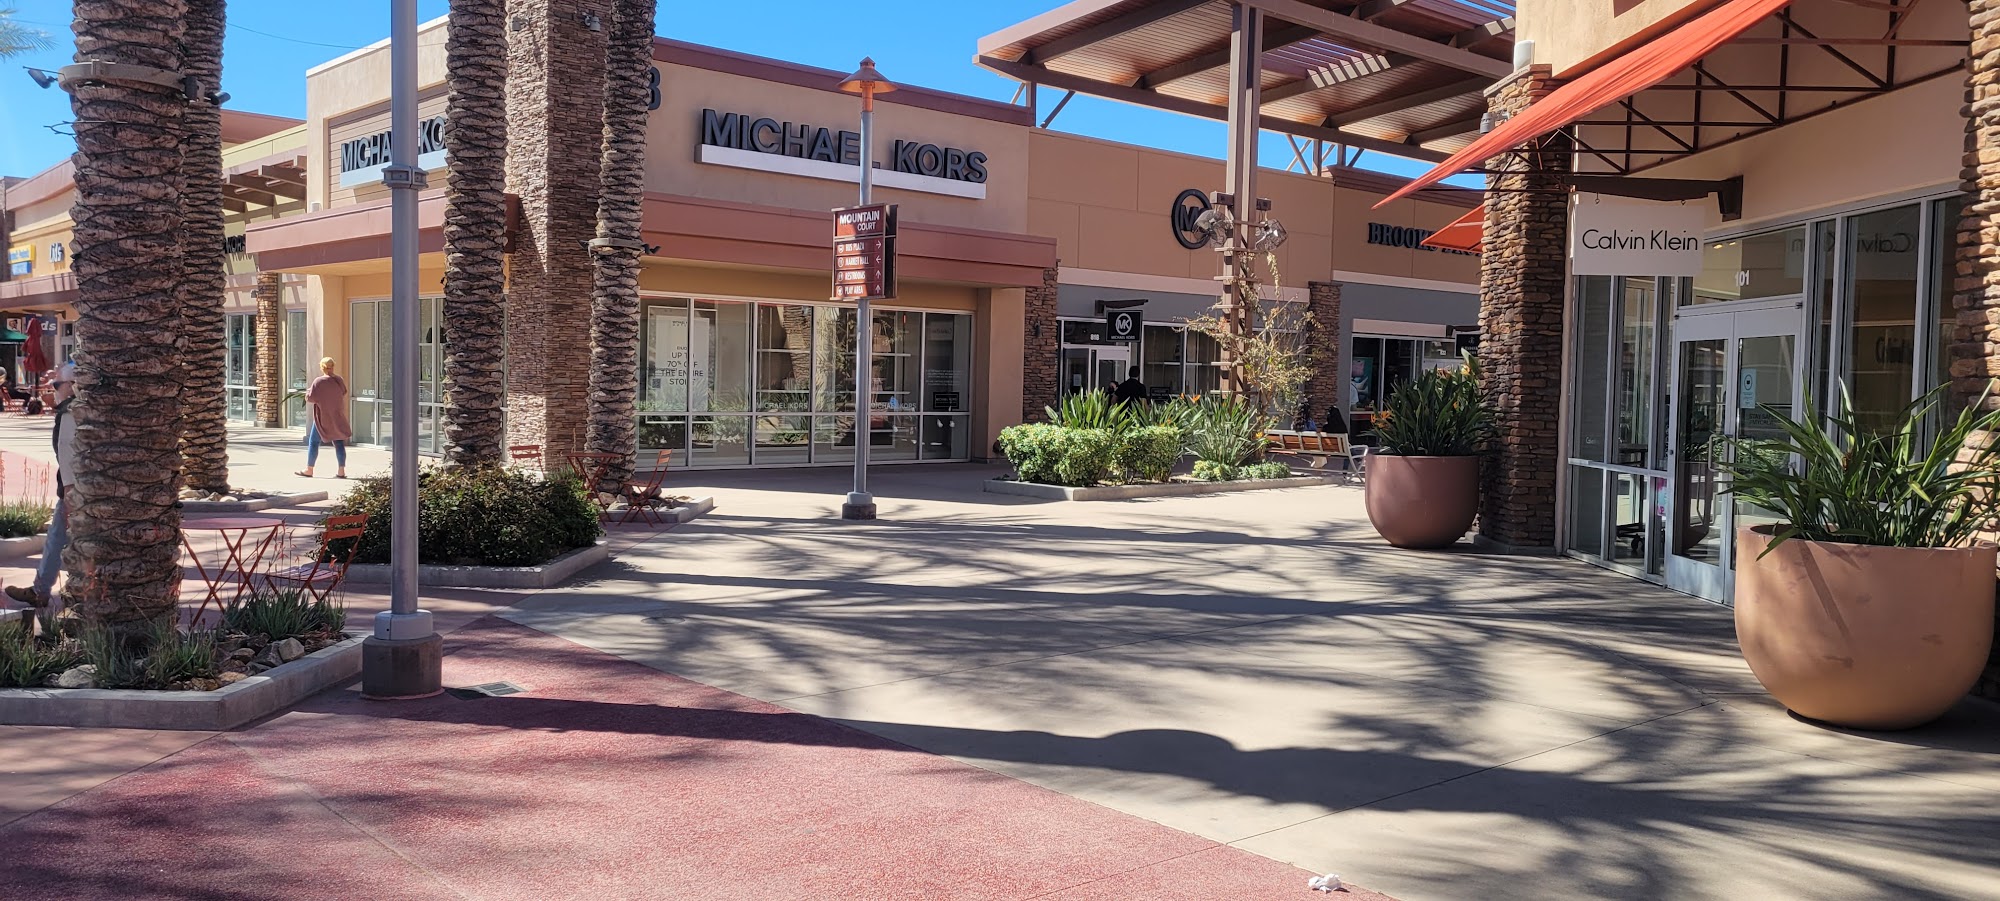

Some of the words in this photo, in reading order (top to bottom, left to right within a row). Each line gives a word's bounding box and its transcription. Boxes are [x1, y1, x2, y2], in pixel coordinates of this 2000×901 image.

[341, 131, 392, 173] MICHA
[419, 116, 446, 153] KO
[894, 139, 988, 184] KORS
[840, 210, 880, 225] MOUNTAIN
[857, 222, 877, 231] COURT
[1582, 229, 1645, 250] Calvin
[1650, 230, 1698, 251] Klein
[1735, 269, 1750, 286] 101
[661, 369, 676, 377] THE
